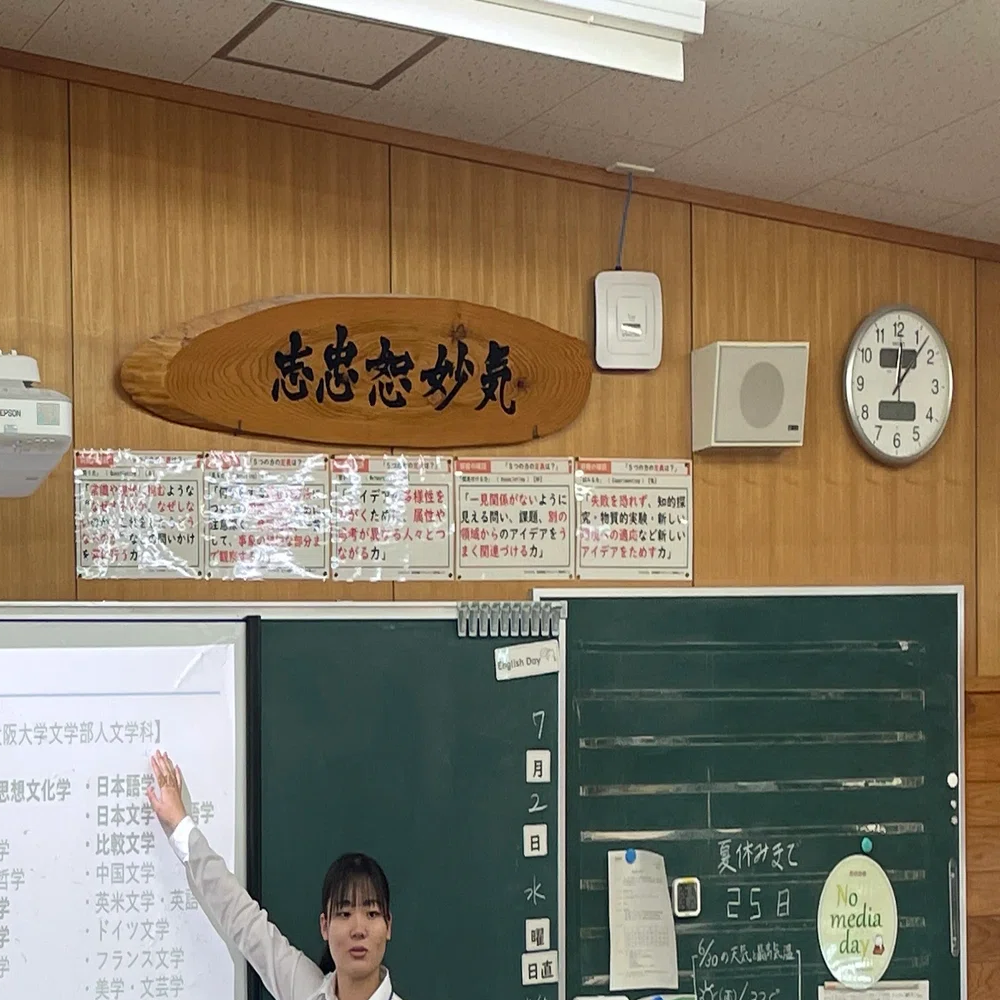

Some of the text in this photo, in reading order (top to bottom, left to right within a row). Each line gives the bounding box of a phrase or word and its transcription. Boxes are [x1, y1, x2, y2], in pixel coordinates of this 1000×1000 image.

[876, 328, 885, 343] 11
[893, 322, 905, 338] 12
[915, 330, 919, 345] 1
[861, 347, 872, 363] 10
[927, 349, 935, 364] 2
[857, 375, 864, 391] 9
[931, 380, 939, 395] 3
[0, 409, 21, 418] EPSON
[862, 404, 869, 420] 8
[926, 407, 933, 422] 4
[875, 425, 883, 440] 7
[893, 432, 901, 448] 6
[913, 426, 920, 441] 5
[497, 656, 541, 671] English Day
[532, 710, 545, 739] 7
[532, 760, 543, 778] 月
[528, 793, 548, 813] 2
[95, 832, 155, 856] 比較文学
[530, 834, 540, 852] 日
[717, 838, 799, 874] 夏休みまで
[96, 861, 155, 885] 中国文学
[523, 874, 546, 906] 水
[836, 884, 858, 909] No
[829, 902, 883, 929] media
[98, 918, 170, 943] ドイツ文学
[530, 926, 544, 947] 曜
[839, 931, 870, 962] day
[96, 947, 185, 971] フランス文学
[527, 959, 554, 980] 日直
[95, 975, 185, 1000] 美学・文芸学
